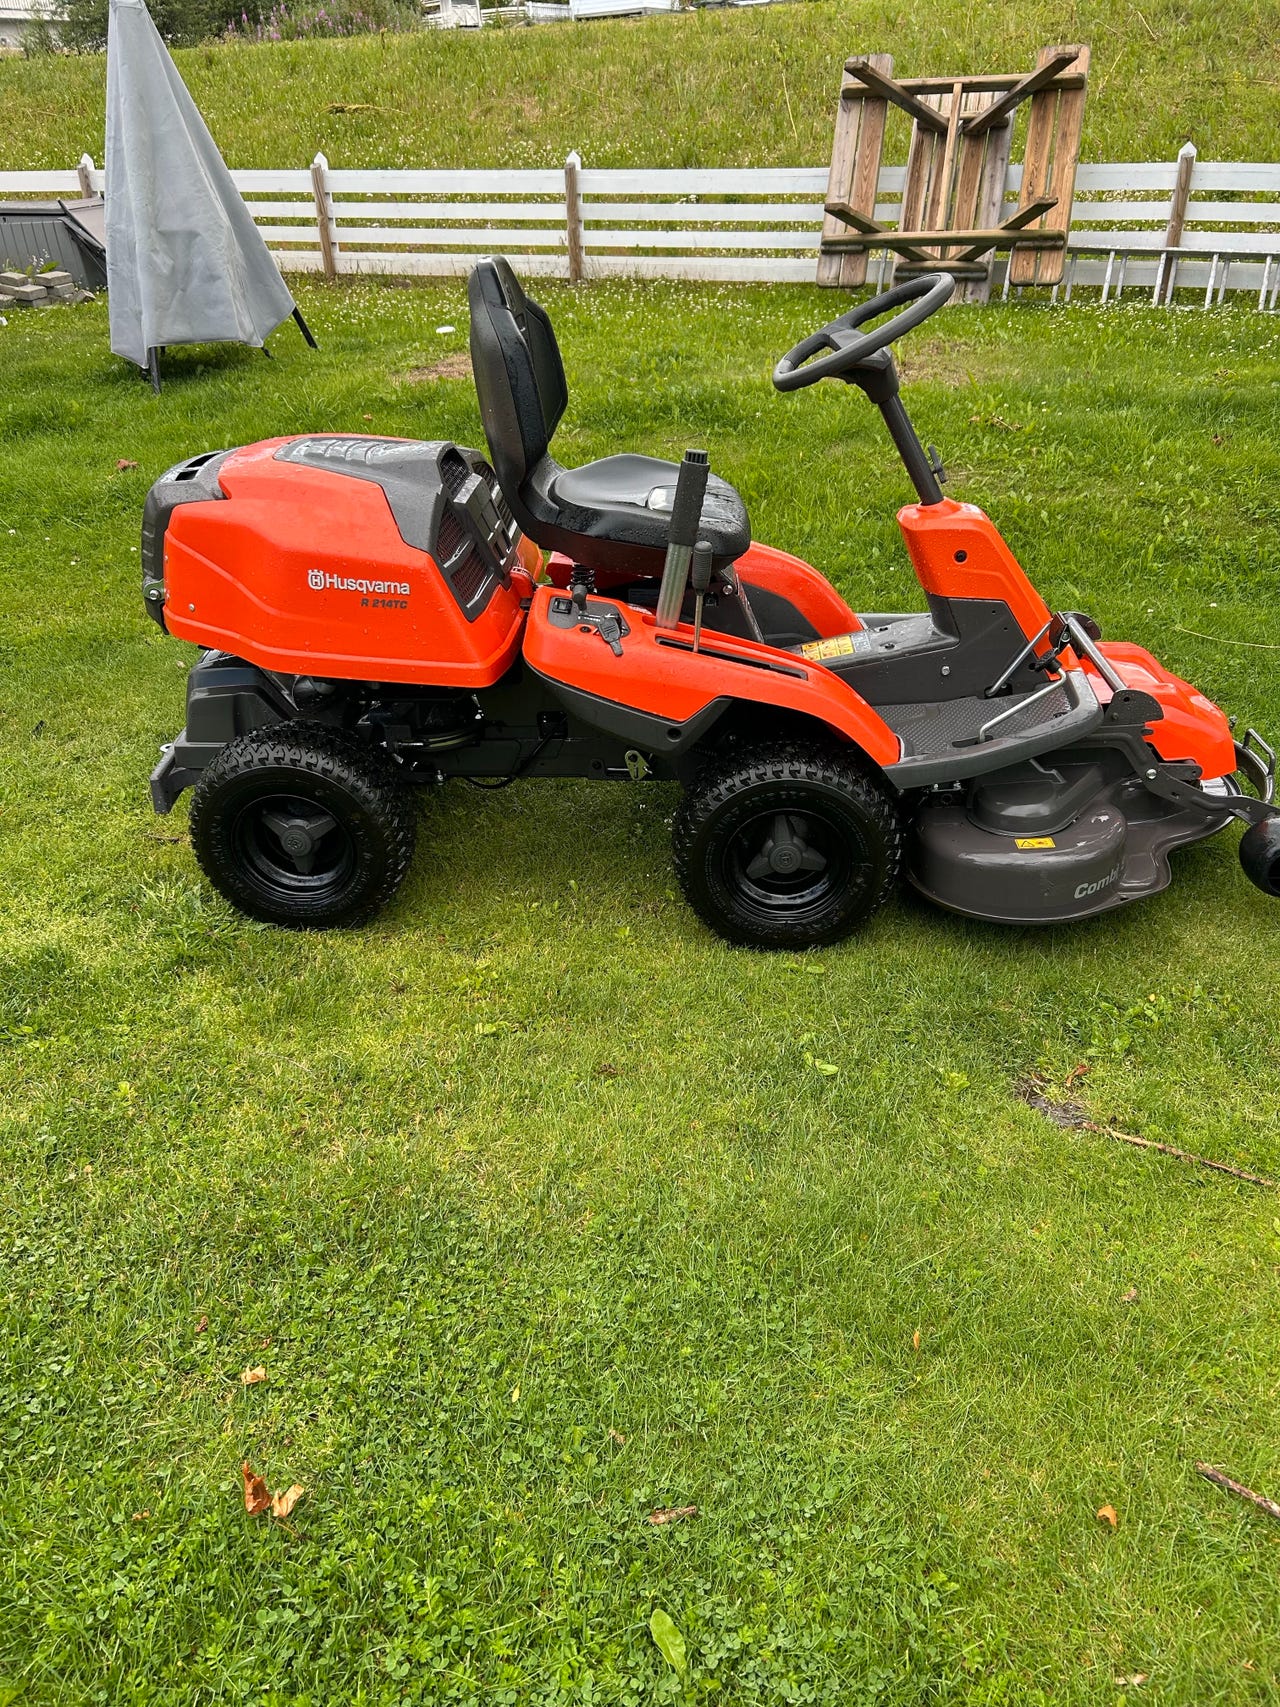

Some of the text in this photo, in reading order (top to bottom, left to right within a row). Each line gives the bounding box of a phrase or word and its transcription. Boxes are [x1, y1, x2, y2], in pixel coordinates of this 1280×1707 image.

[325, 573, 410, 595] Husqvarna
[361, 598, 408, 609] R 214TC
